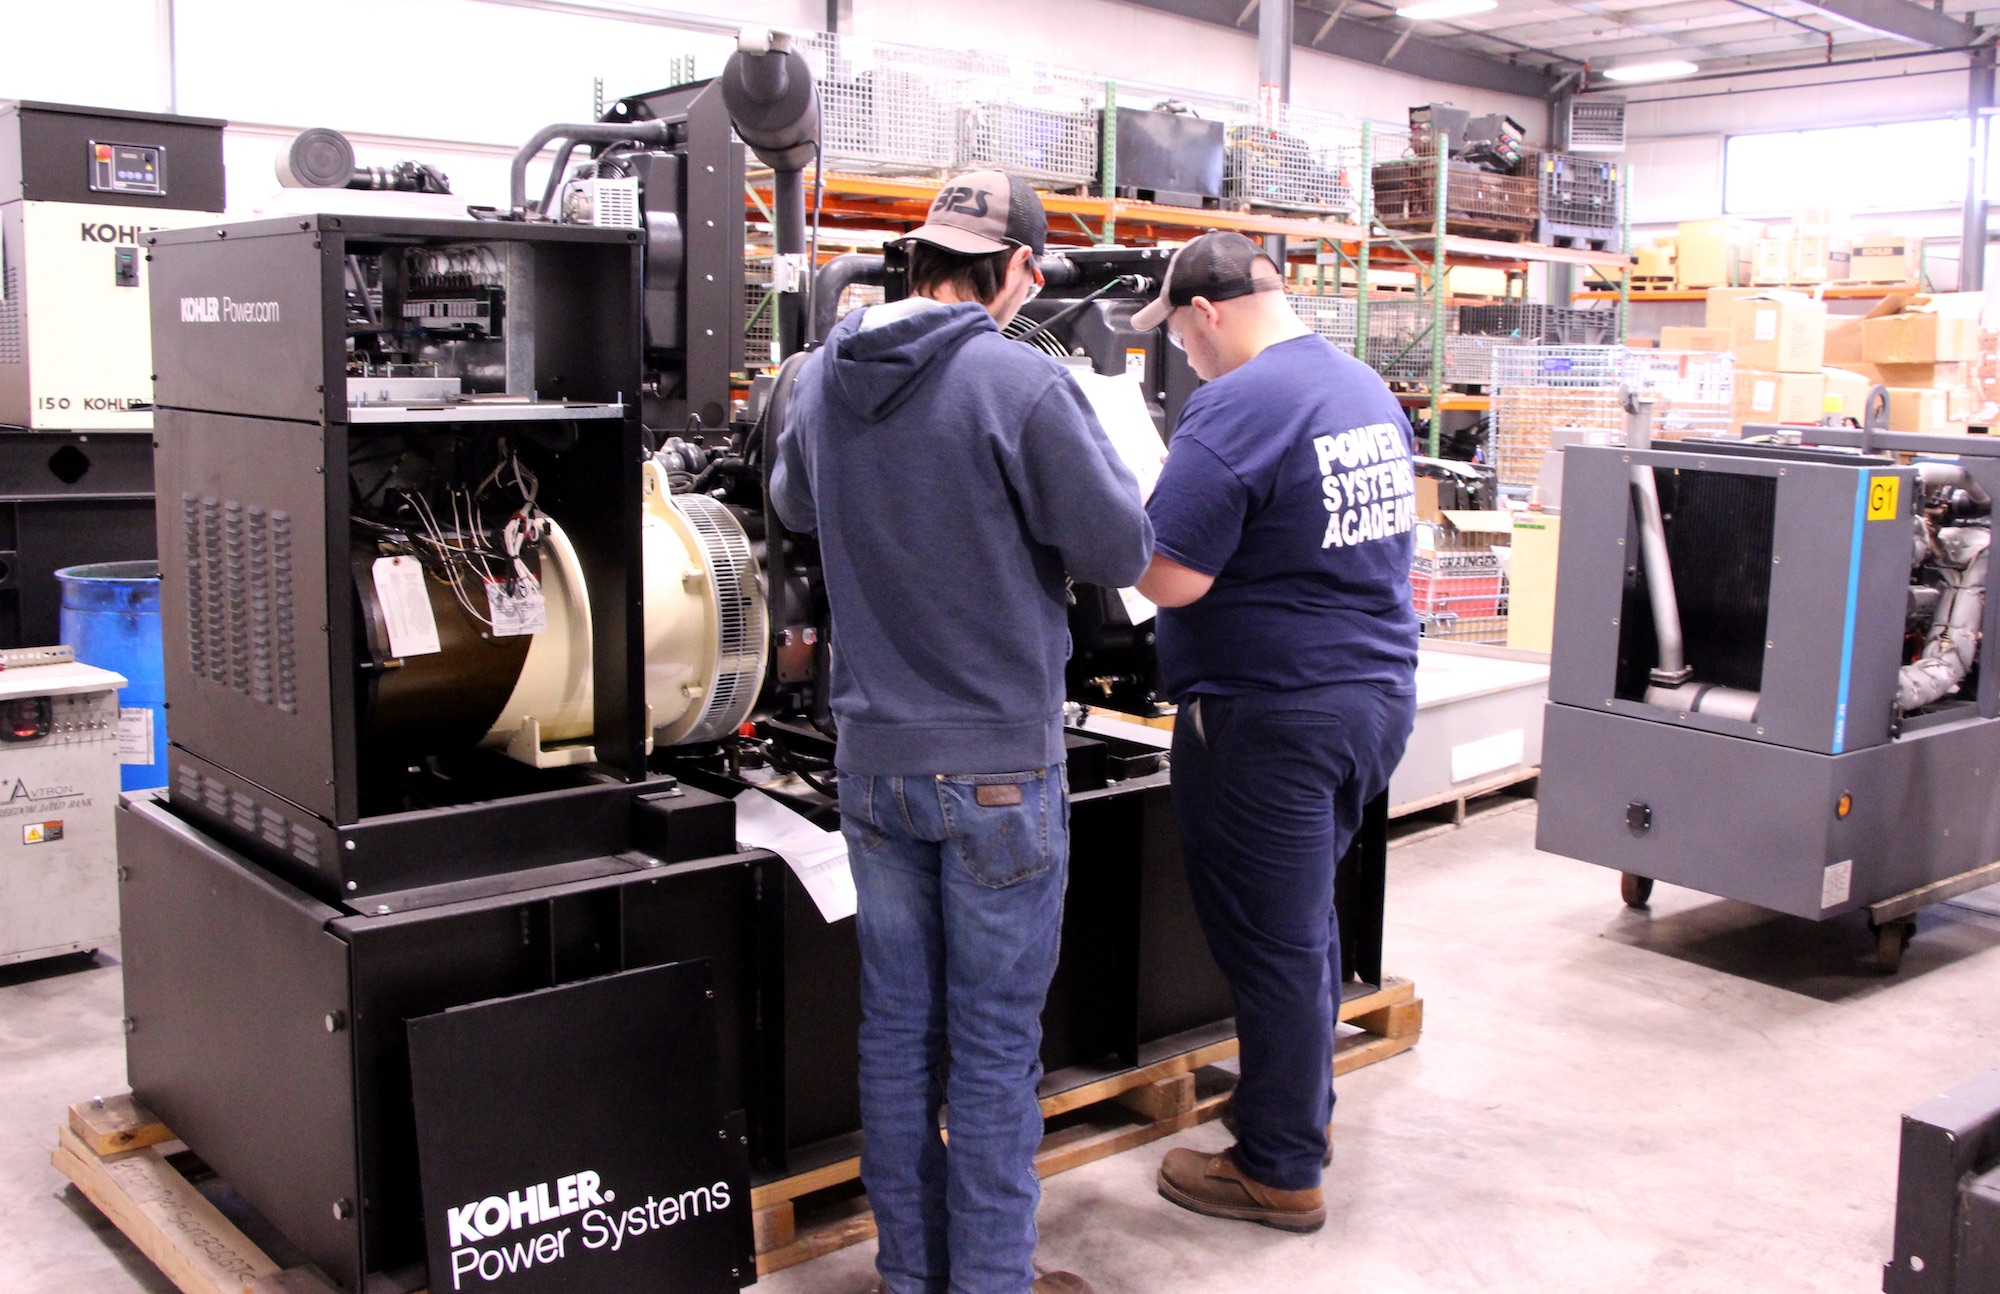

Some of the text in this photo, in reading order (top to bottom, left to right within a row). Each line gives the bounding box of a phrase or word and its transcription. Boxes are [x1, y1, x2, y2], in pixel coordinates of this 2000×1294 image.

[180, 296, 280, 322] KOHLER Power.com
[38, 397, 71, 411] 150
[1313, 422, 1407, 476] POWER
[1321, 458, 1414, 512] SYSTEMS
[1871, 484, 1893, 511] G1
[1439, 554, 1499, 569] GRAINGER
[9, 777, 74, 802] AVTRON
[451, 1181, 731, 1290] Power Systems
